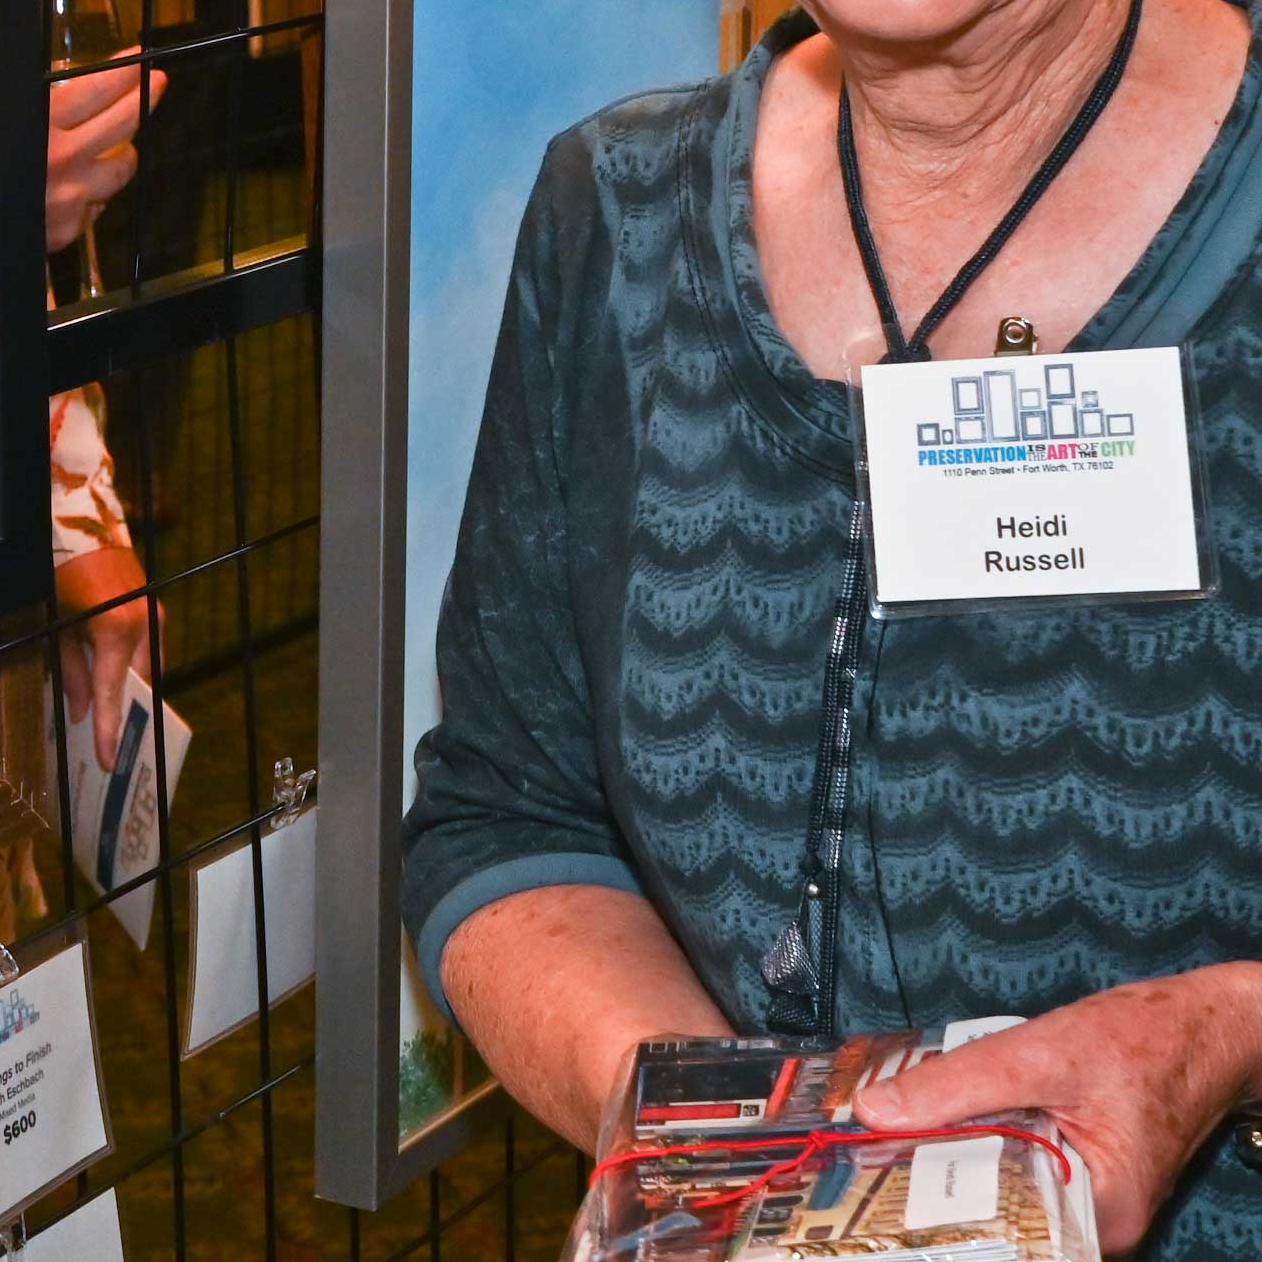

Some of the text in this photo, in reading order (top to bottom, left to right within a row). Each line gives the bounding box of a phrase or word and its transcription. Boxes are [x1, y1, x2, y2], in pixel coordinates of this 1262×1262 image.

[918, 444, 1047, 466] PRESERVATION IS
[1046, 442, 1099, 460] ART OF
[1079, 440, 1136, 459] THE CITY
[943, 468, 963, 477] 1110
[964, 466, 987, 476] Penn
[989, 465, 1015, 475] Street
[1022, 464, 1041, 474] Fort
[1073, 462, 1086, 471] TX
[1087, 461, 1114, 471] 76102
[996, 515, 1068, 539] Heidi
[984, 547, 1086, 572] Russell
[15, 1061, 24, 1075] to
[25, 1042, 52, 1068] Finish
[6, 1069, 45, 1100] Eschbach
[3, 1110, 37, 1146] $600
